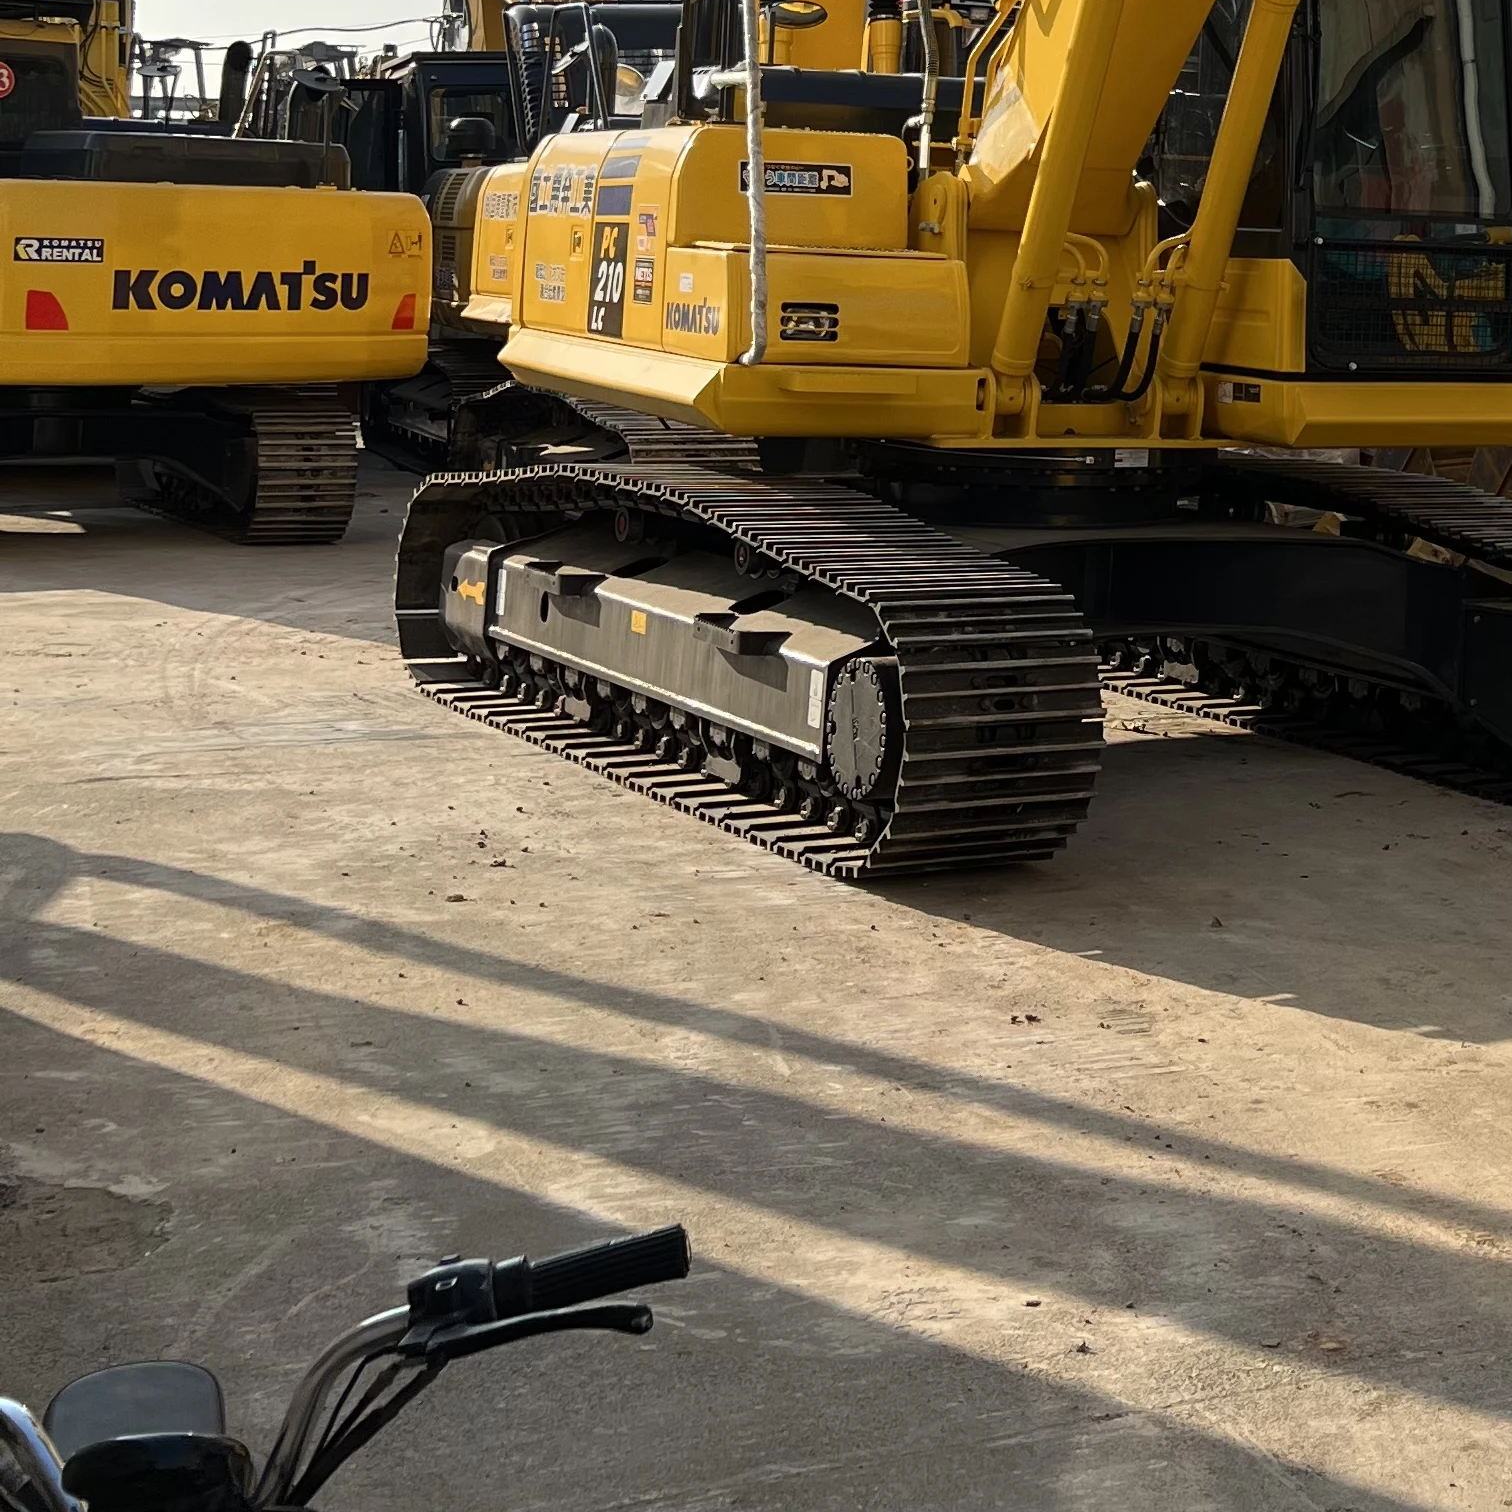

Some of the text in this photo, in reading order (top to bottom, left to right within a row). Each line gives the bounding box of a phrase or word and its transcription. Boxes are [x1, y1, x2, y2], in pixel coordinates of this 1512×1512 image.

[41, 248, 102, 261] RENTAL
[43, 239, 101, 247] KOMATSU
[600, 227, 618, 258] PC
[112, 260, 369, 310] KOMATSU
[594, 261, 624, 303] 210
[591, 306, 605, 330] LC
[666, 297, 720, 336] KOMATSU
